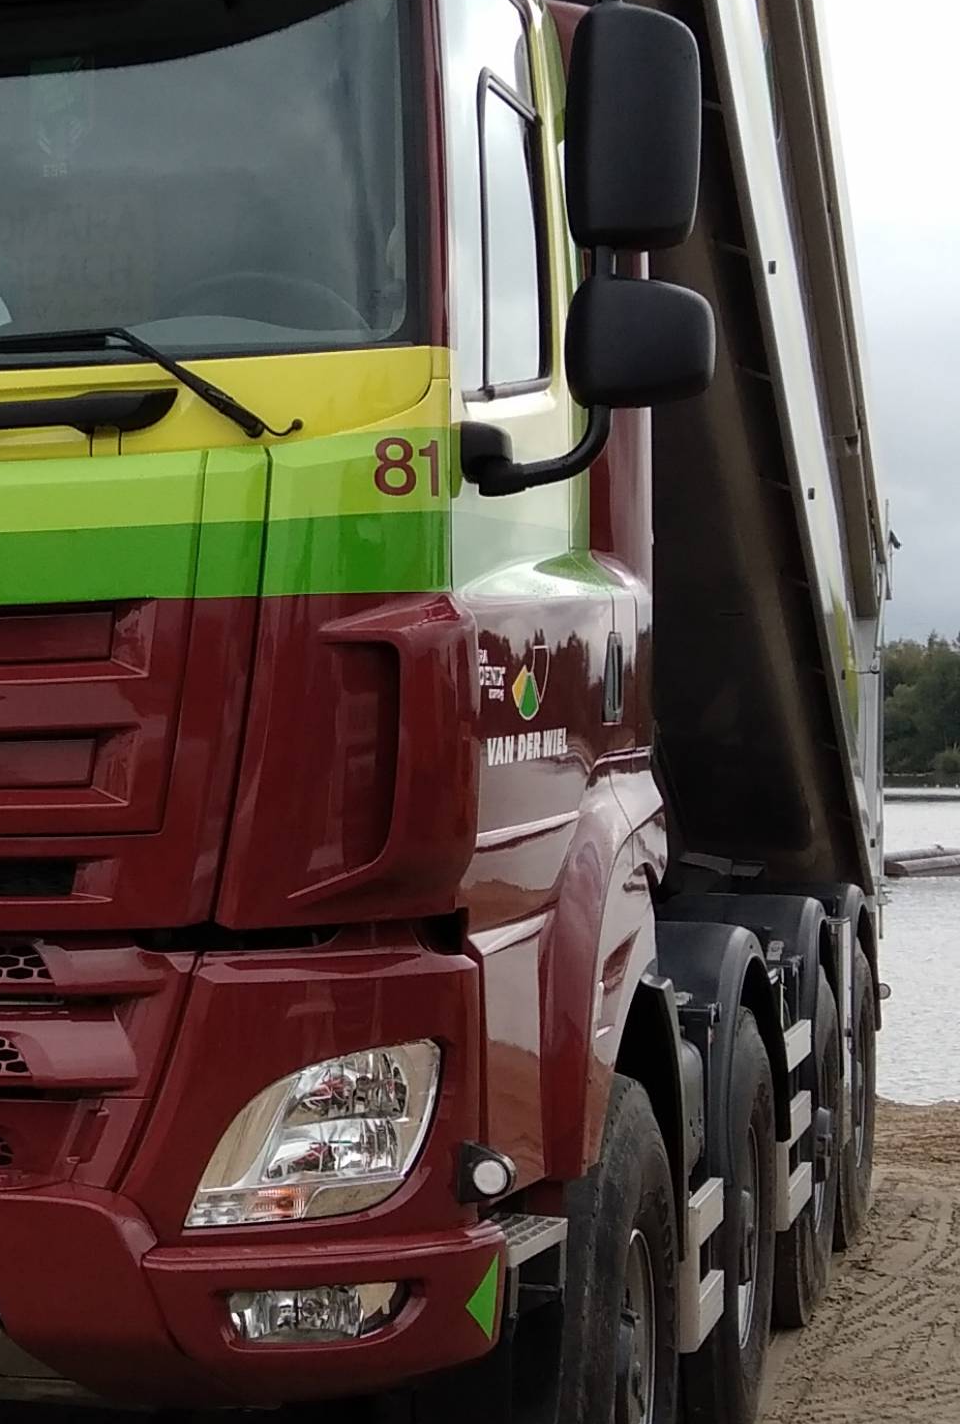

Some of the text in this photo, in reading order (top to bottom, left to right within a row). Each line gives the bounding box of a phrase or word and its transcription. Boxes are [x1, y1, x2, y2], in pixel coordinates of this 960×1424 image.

[373, 437, 439, 497] 81
[487, 727, 568, 766] VAN DER WIEL
